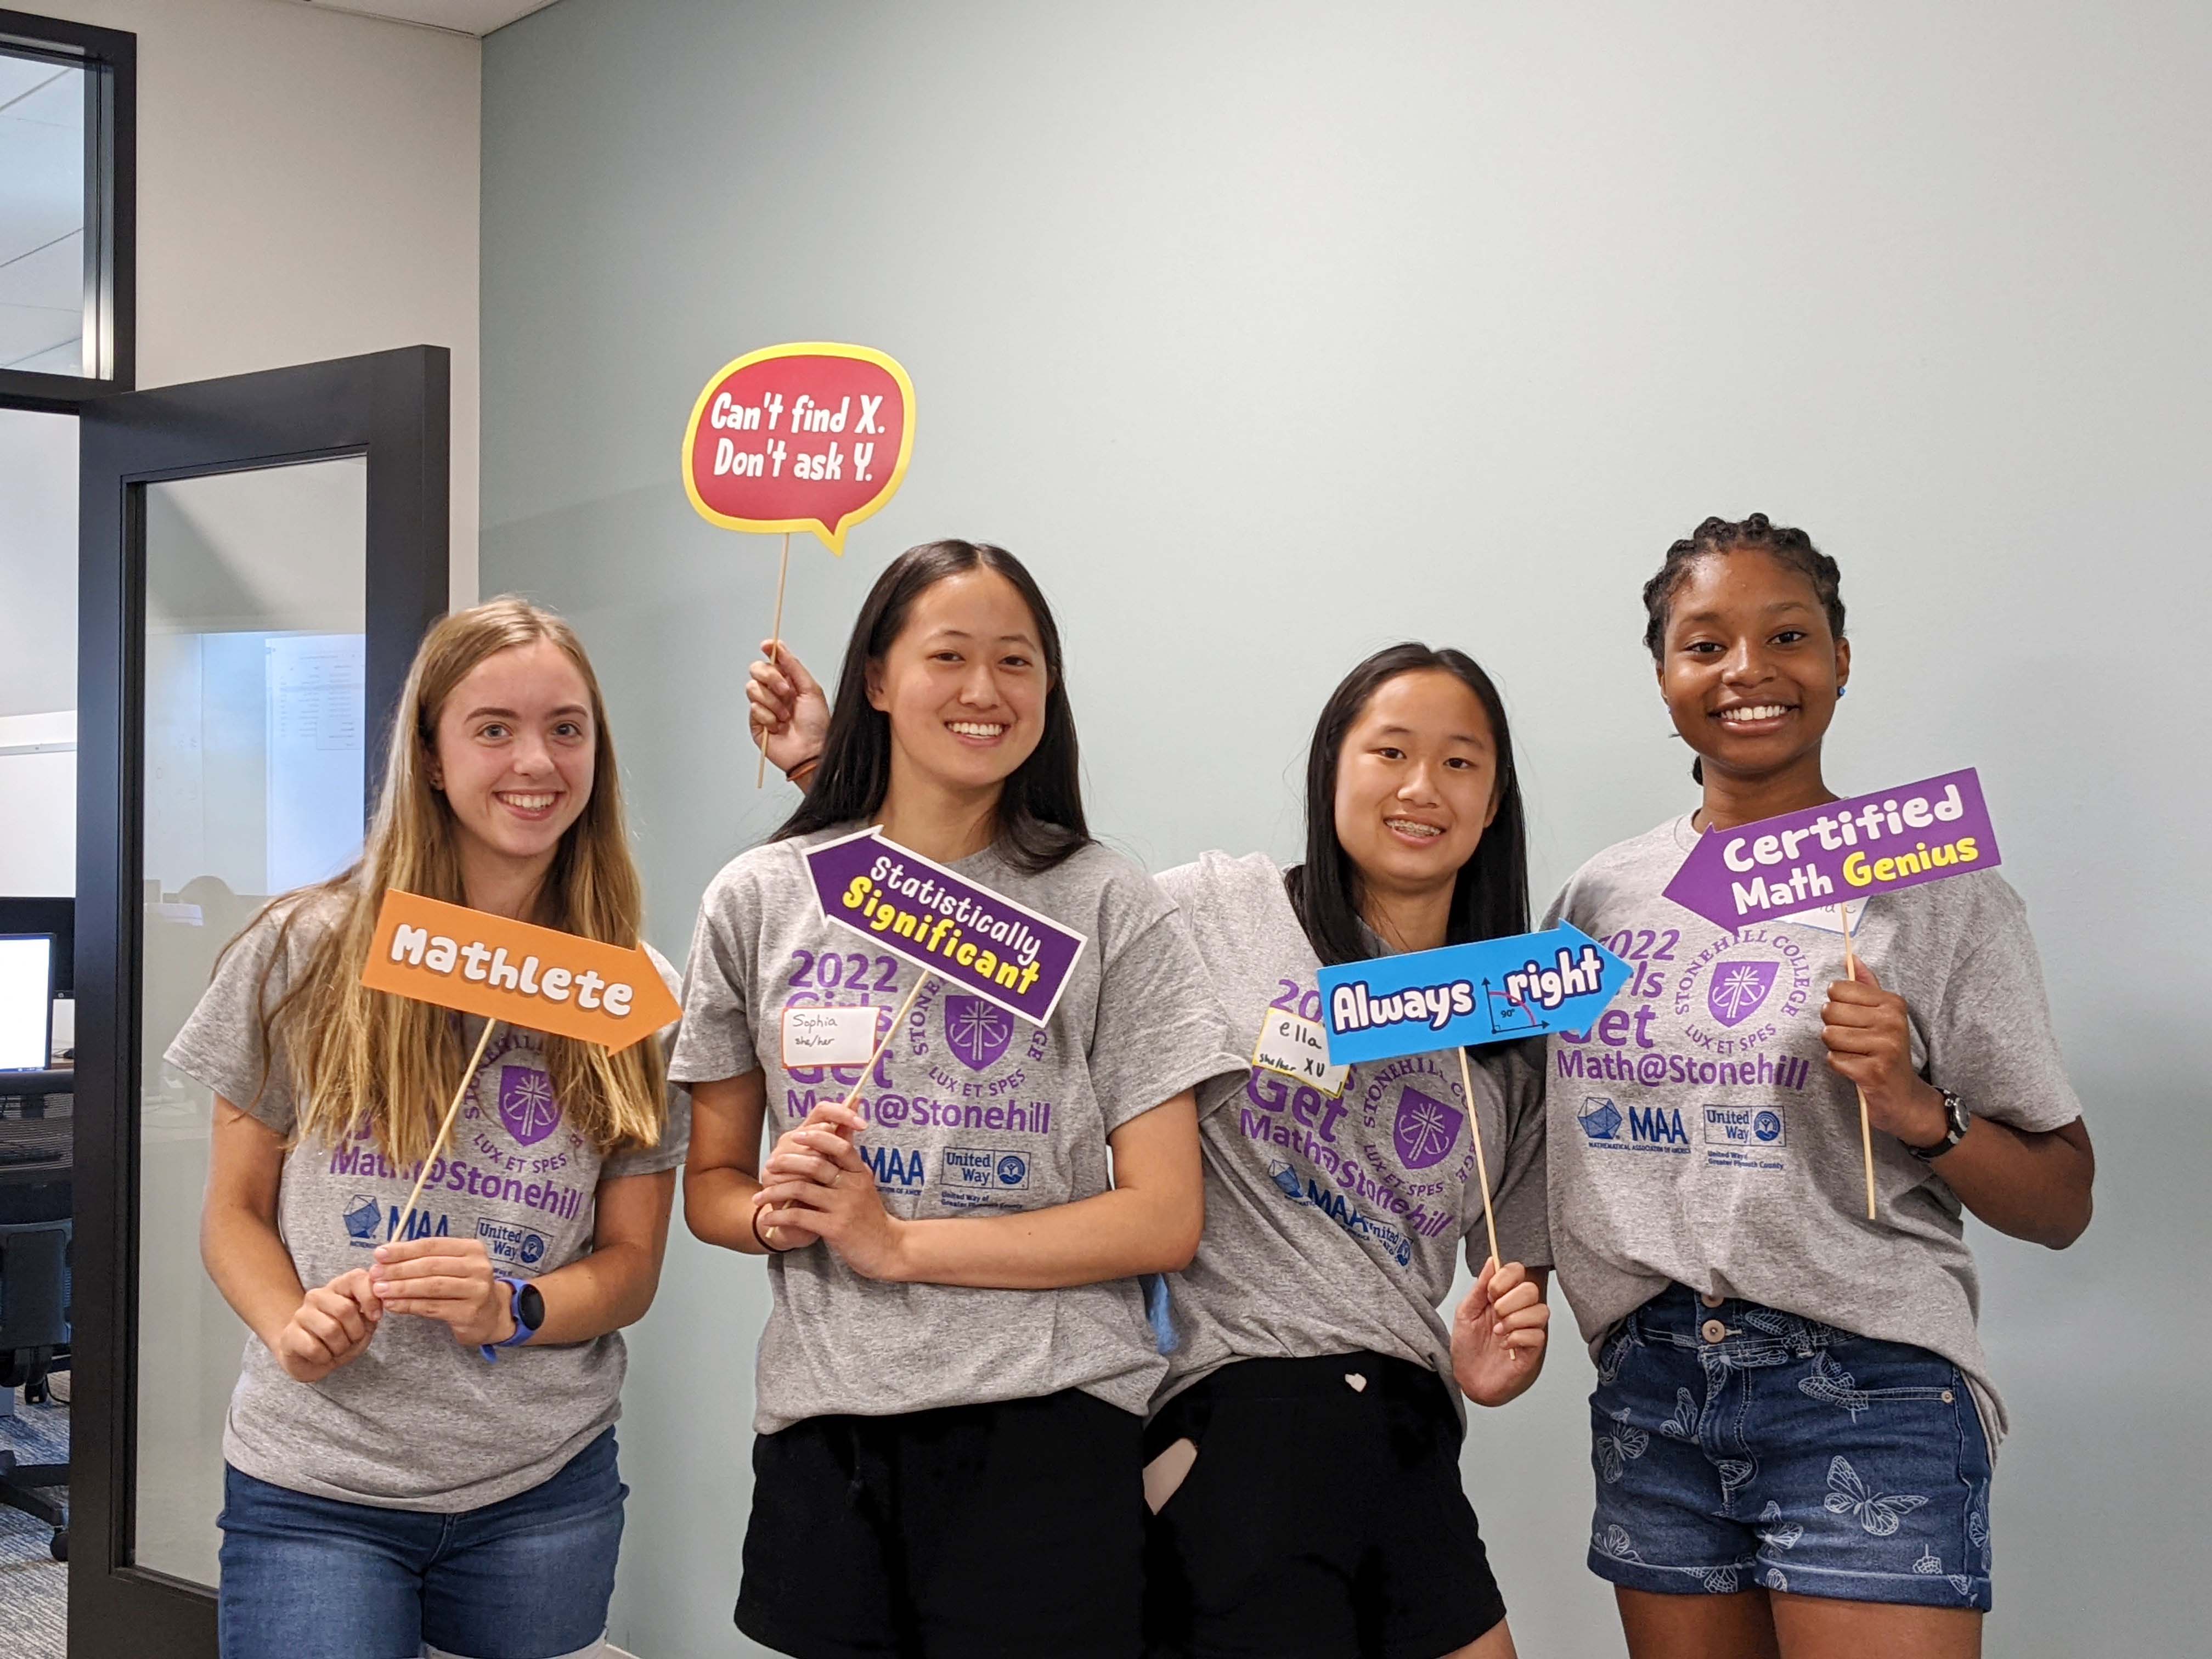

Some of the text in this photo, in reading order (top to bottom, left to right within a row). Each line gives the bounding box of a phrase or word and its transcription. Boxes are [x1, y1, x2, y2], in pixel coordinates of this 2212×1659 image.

[711, 392, 885, 434] Can't find X.
[714, 438, 874, 481] Don't ask Y.
[1723, 784, 1963, 872] Certified
[1732, 838, 1978, 916] Math Genius
[871, 856, 1041, 966] Statistically
[843, 877, 1040, 995] Significant
[391, 924, 633, 1016] Mathlete
[788, 950, 898, 992] 2022
[1332, 981, 1474, 1032] Always
[1505, 946, 1602, 1008] right
[1675, 929, 1768, 1015] STONEHILL
[1773, 935, 1810, 1017] COLLEGE
[793, 1014, 837, 1034] Sophia
[1500, 1008, 1515, 1018] 90°
[795, 1035, 834, 1047] she/her
[1685, 1023, 1776, 1054] LUX ET SPES
[929, 1066, 1025, 1097] LUX ET SPES
[1557, 1050, 1809, 1090] Math@Stonehill
[1629, 1106, 1689, 1144] MAA
[1706, 1109, 1750, 1125] United
[1725, 1125, 1749, 1143] Way
[474, 1133, 566, 1173] LUX ET SPES
[860, 1146, 924, 1186] MAA
[946, 1152, 991, 1167] United
[1364, 1144, 1443, 1197] LUX ET SPES
[329, 1144, 584, 1221] Mat@Stonehill
[962, 1168, 990, 1186] Way
[480, 1223, 522, 1243] United
[494, 1240, 518, 1260] Way
